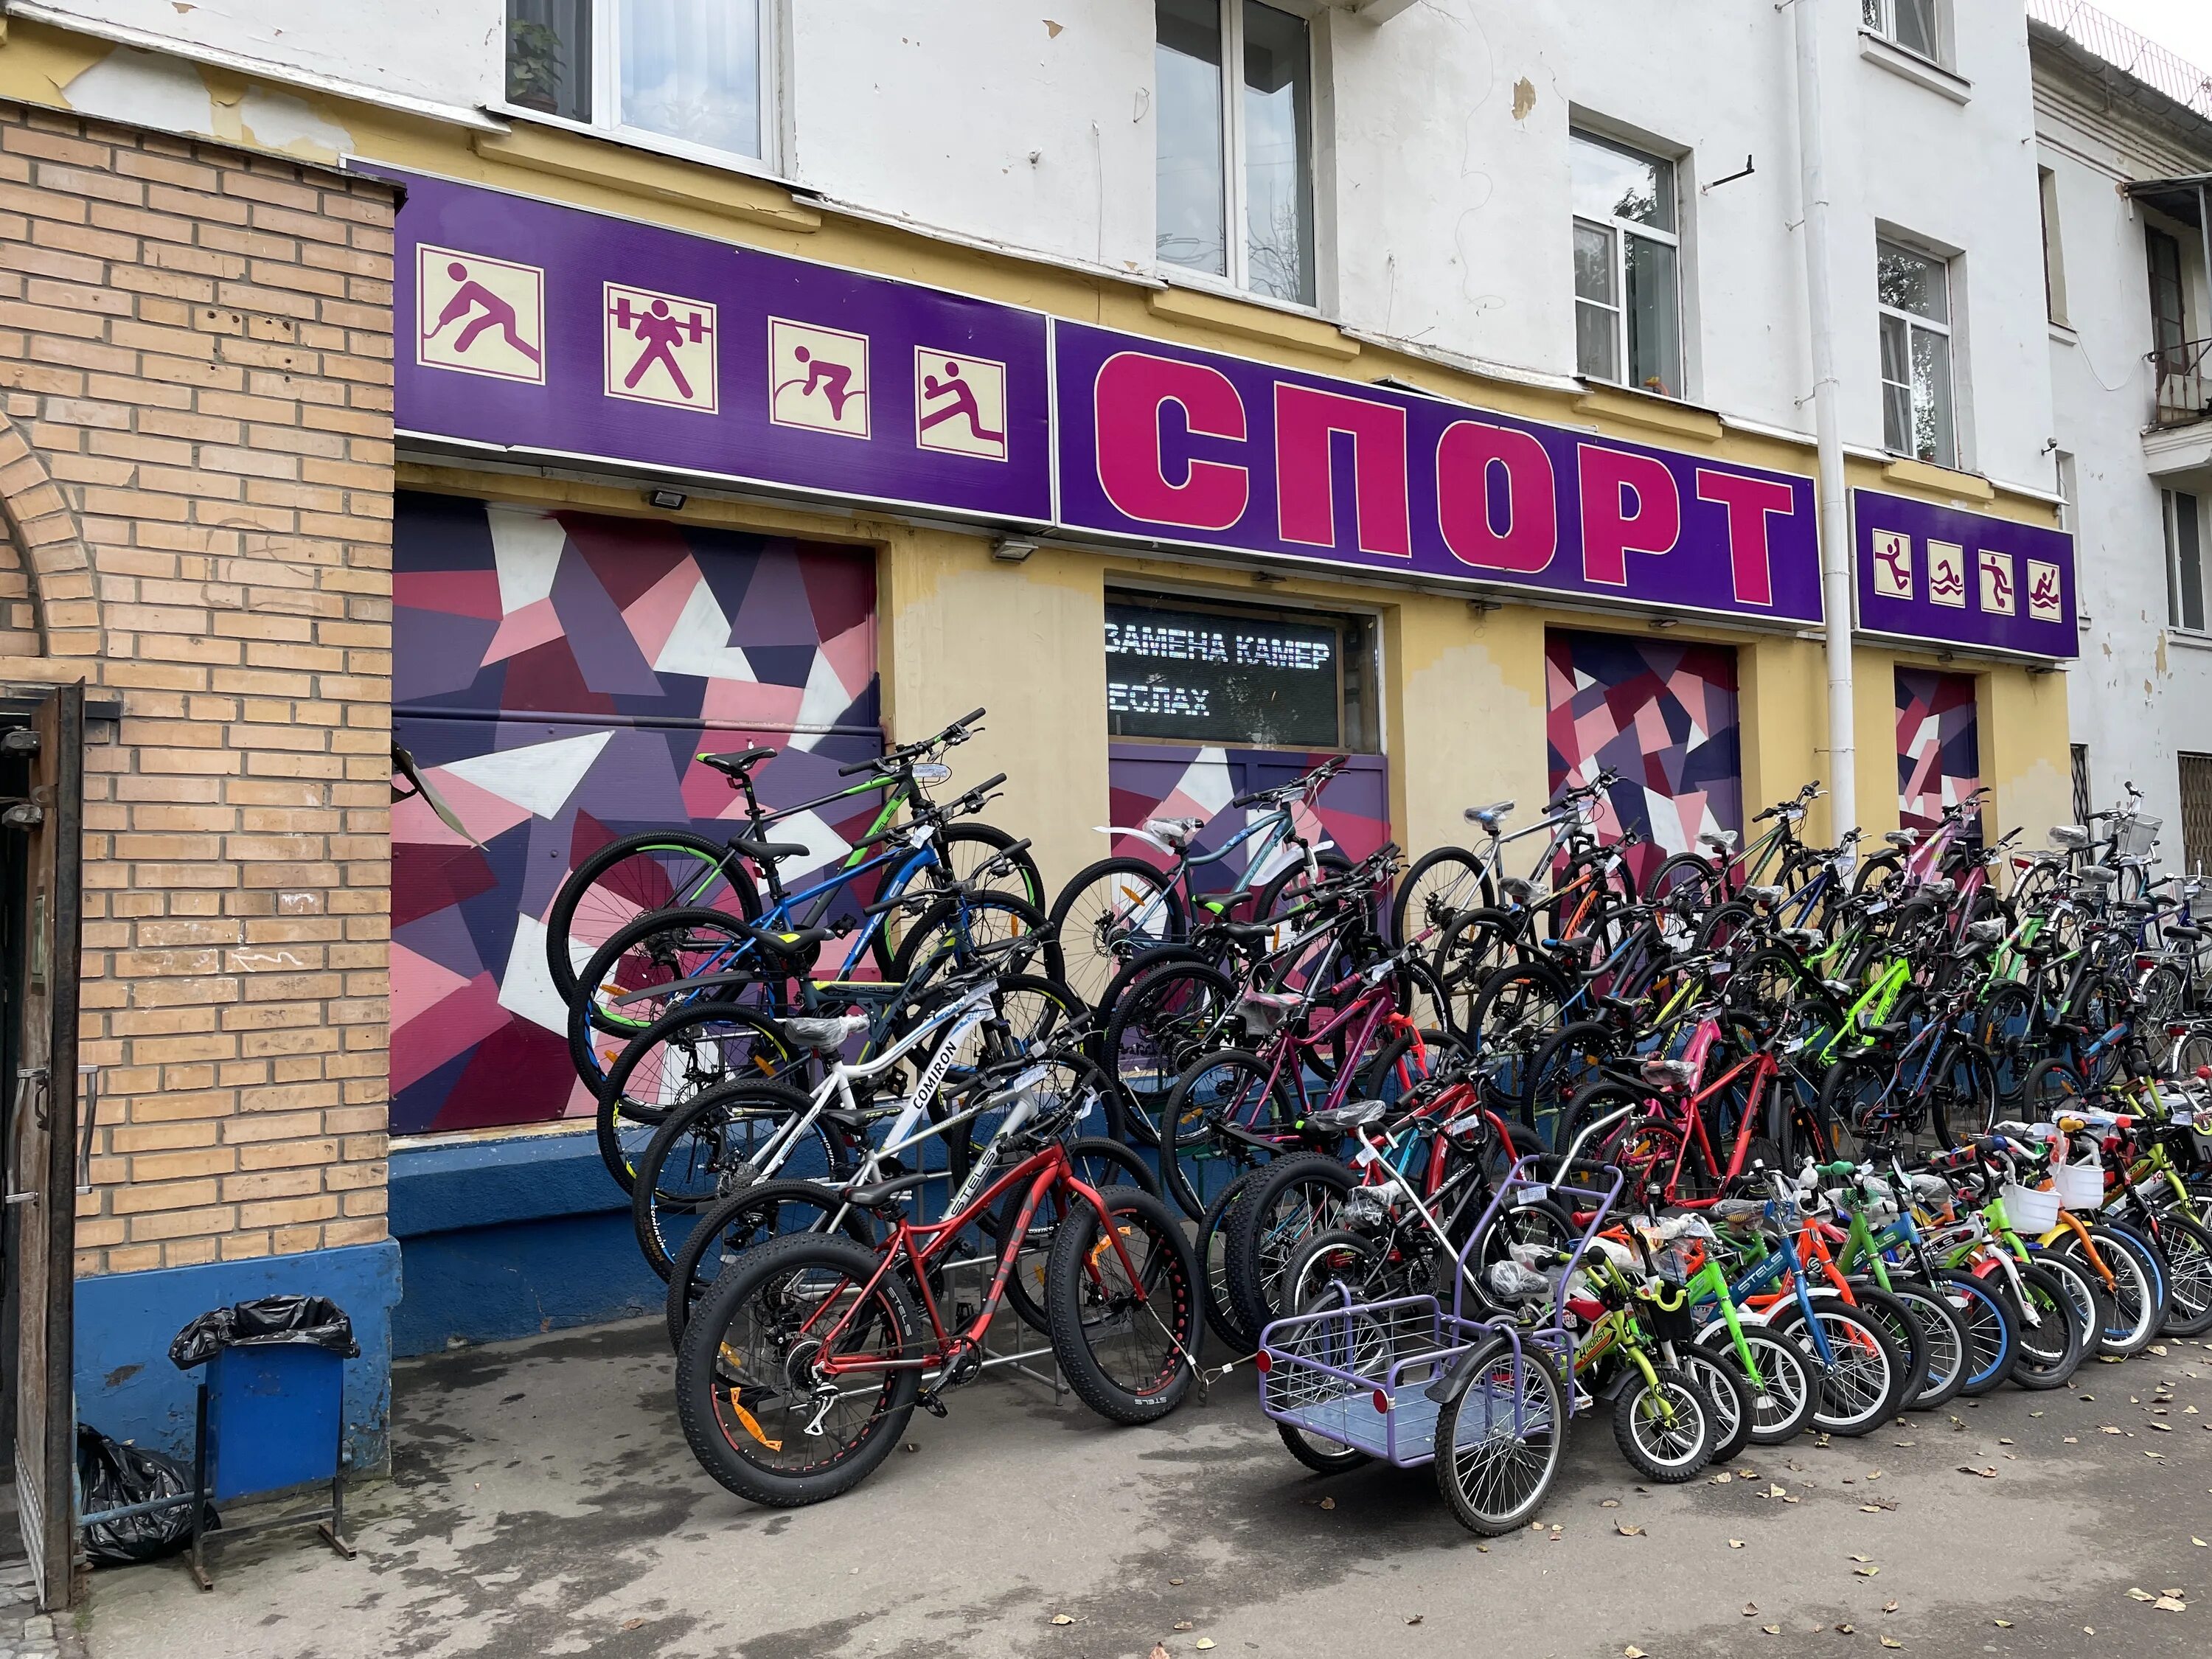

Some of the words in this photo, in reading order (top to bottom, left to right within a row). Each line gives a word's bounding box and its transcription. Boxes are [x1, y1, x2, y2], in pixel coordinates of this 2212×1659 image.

[1094, 351, 1794, 607] СПОРТ
[1105, 623, 1229, 663] ЗАМЕНА
[1236, 636, 1330, 669] КАМЕР
[1877, 987, 1898, 1025] TELS
[913, 1040, 957, 1110] COMIRON
[950, 1149, 995, 1217] STELS
[650, 1204, 666, 1249] COMIRON
[1852, 1232, 1896, 1267] STLS
[1737, 1251, 1784, 1294] STELS
[886, 1286, 913, 1337] STELS
[1586, 1329, 1606, 1352] HORST
[1135, 1397, 1167, 1406] STELS
